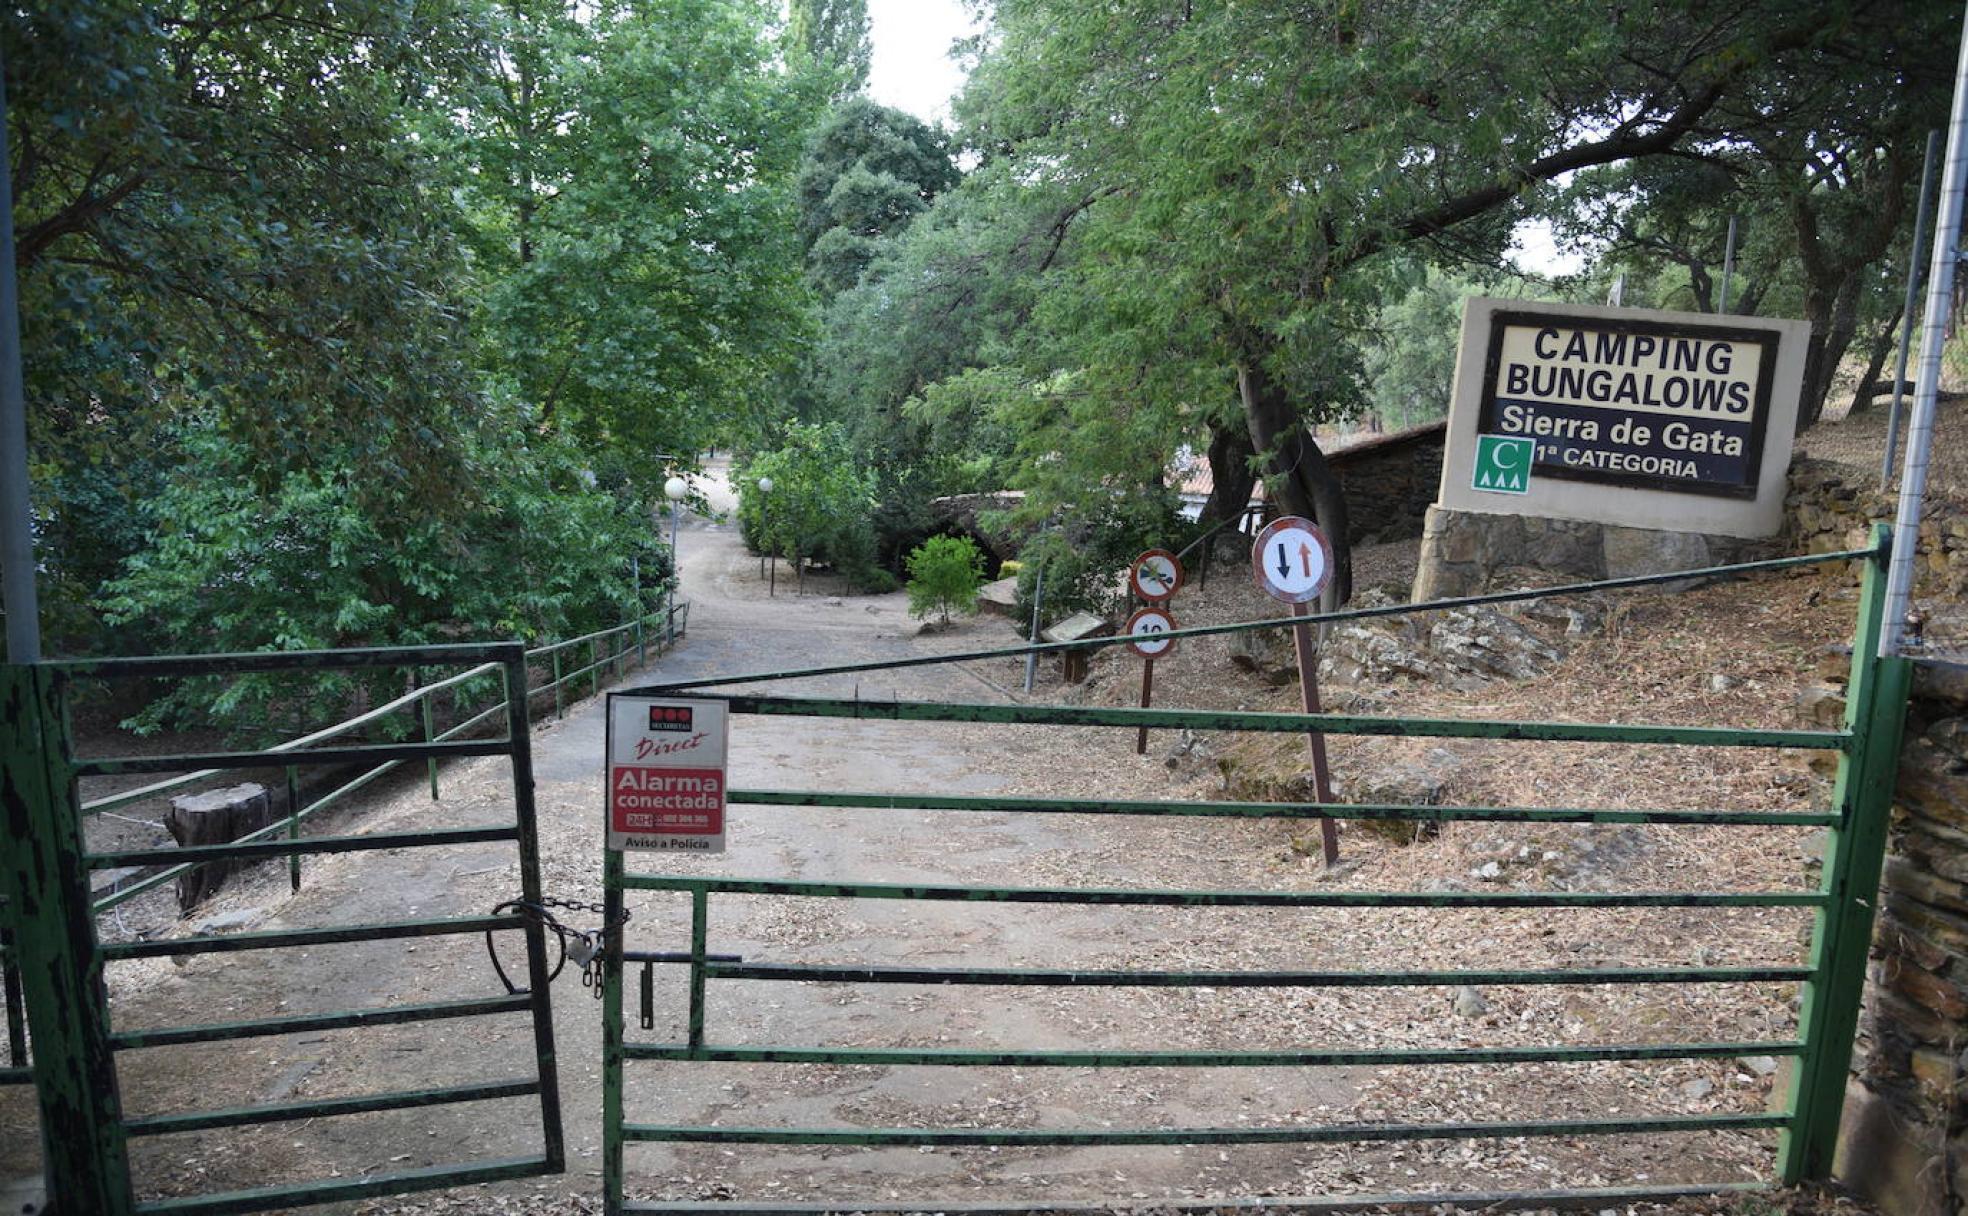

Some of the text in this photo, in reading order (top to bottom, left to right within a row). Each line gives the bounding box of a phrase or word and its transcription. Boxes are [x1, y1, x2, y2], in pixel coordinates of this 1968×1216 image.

[1534, 327, 1733, 375] CAMPING
[1506, 363, 1750, 414] BUNGALOWS
[1501, 405, 1743, 457] Sierra de Gata
[1491, 442, 1519, 469] C
[1563, 447, 1698, 479] CATEGORIA
[635, 731, 711, 760] Direct
[617, 770, 718, 792] Alarma
[617, 793, 719, 809] conectada
[625, 837, 658, 849] Aviso
[660, 841, 667, 849] a
